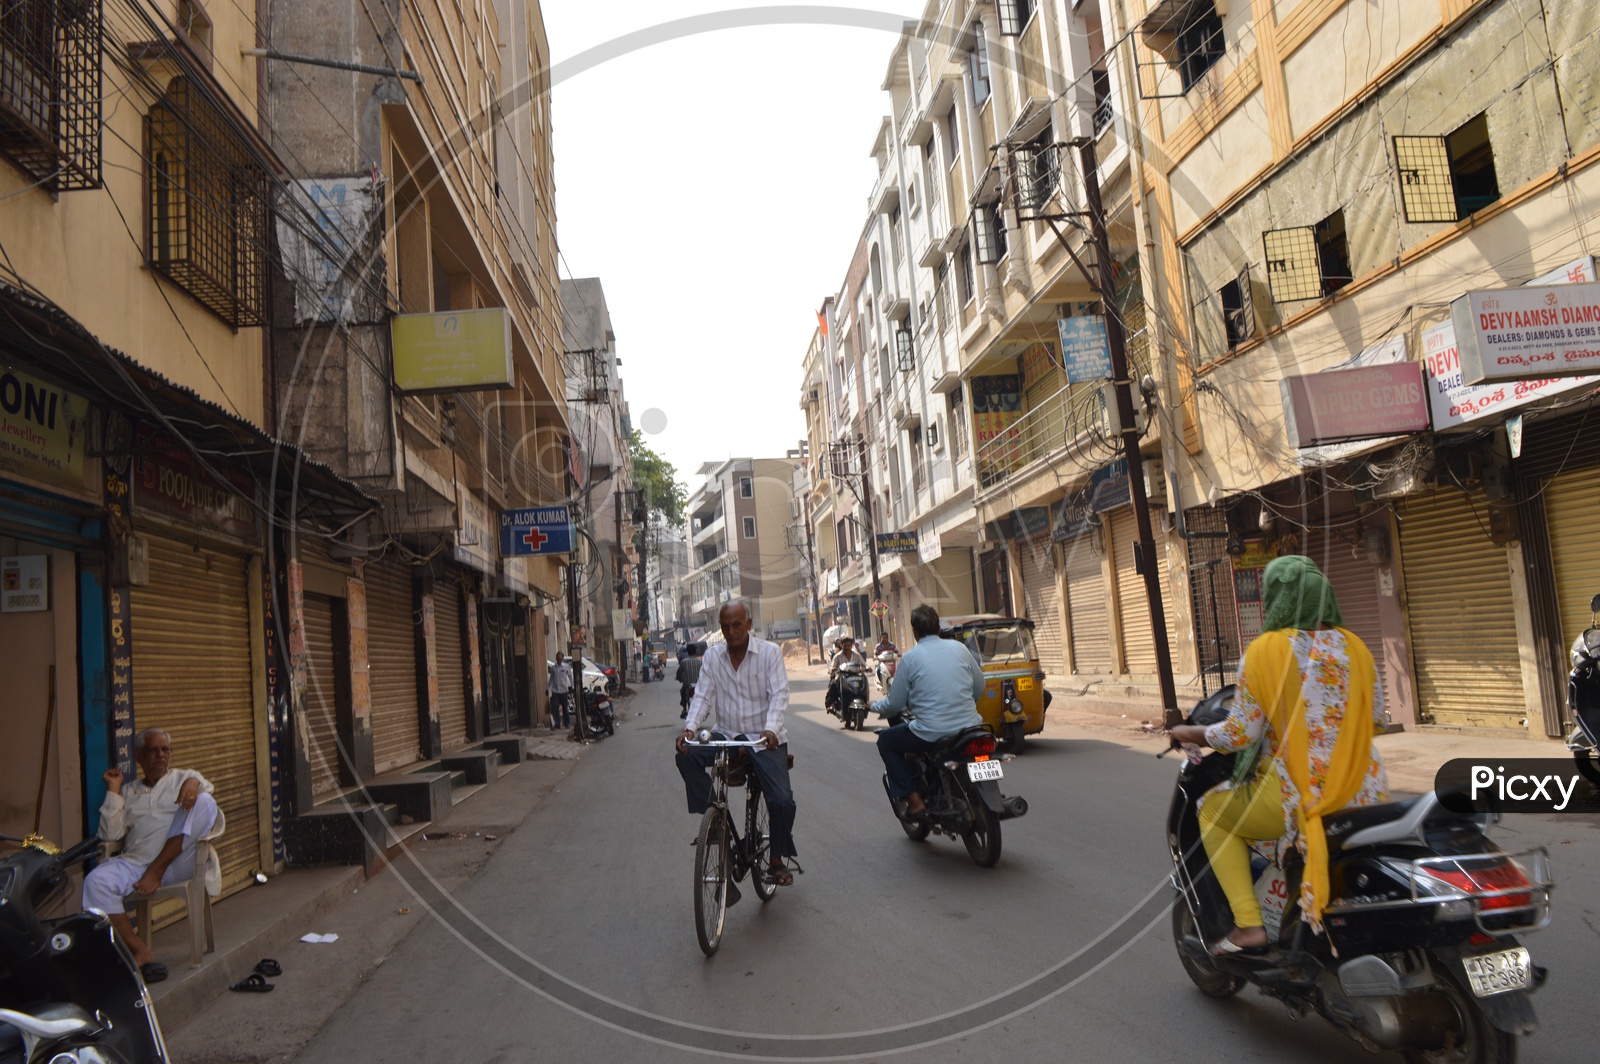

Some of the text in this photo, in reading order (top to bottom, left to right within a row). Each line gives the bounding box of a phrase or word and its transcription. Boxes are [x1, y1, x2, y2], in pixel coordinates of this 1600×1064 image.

[1480, 308, 1558, 331] DEVYAAMSH
[1487, 334, 1524, 344] DEALERS:
[1526, 329, 1565, 341] DIAMONDS
[1567, 328, 1573, 337] &
[1575, 326, 1596, 337] GEMS
[1369, 382, 1421, 408] GEMS
[1380, 417, 1425, 430] Available
[1, 418, 47, 452] Jewellery
[159, 464, 195, 509] POOJA
[502, 509, 566, 527] Dr. ALOK KUMAR
[1475, 957, 1495, 974] TS
